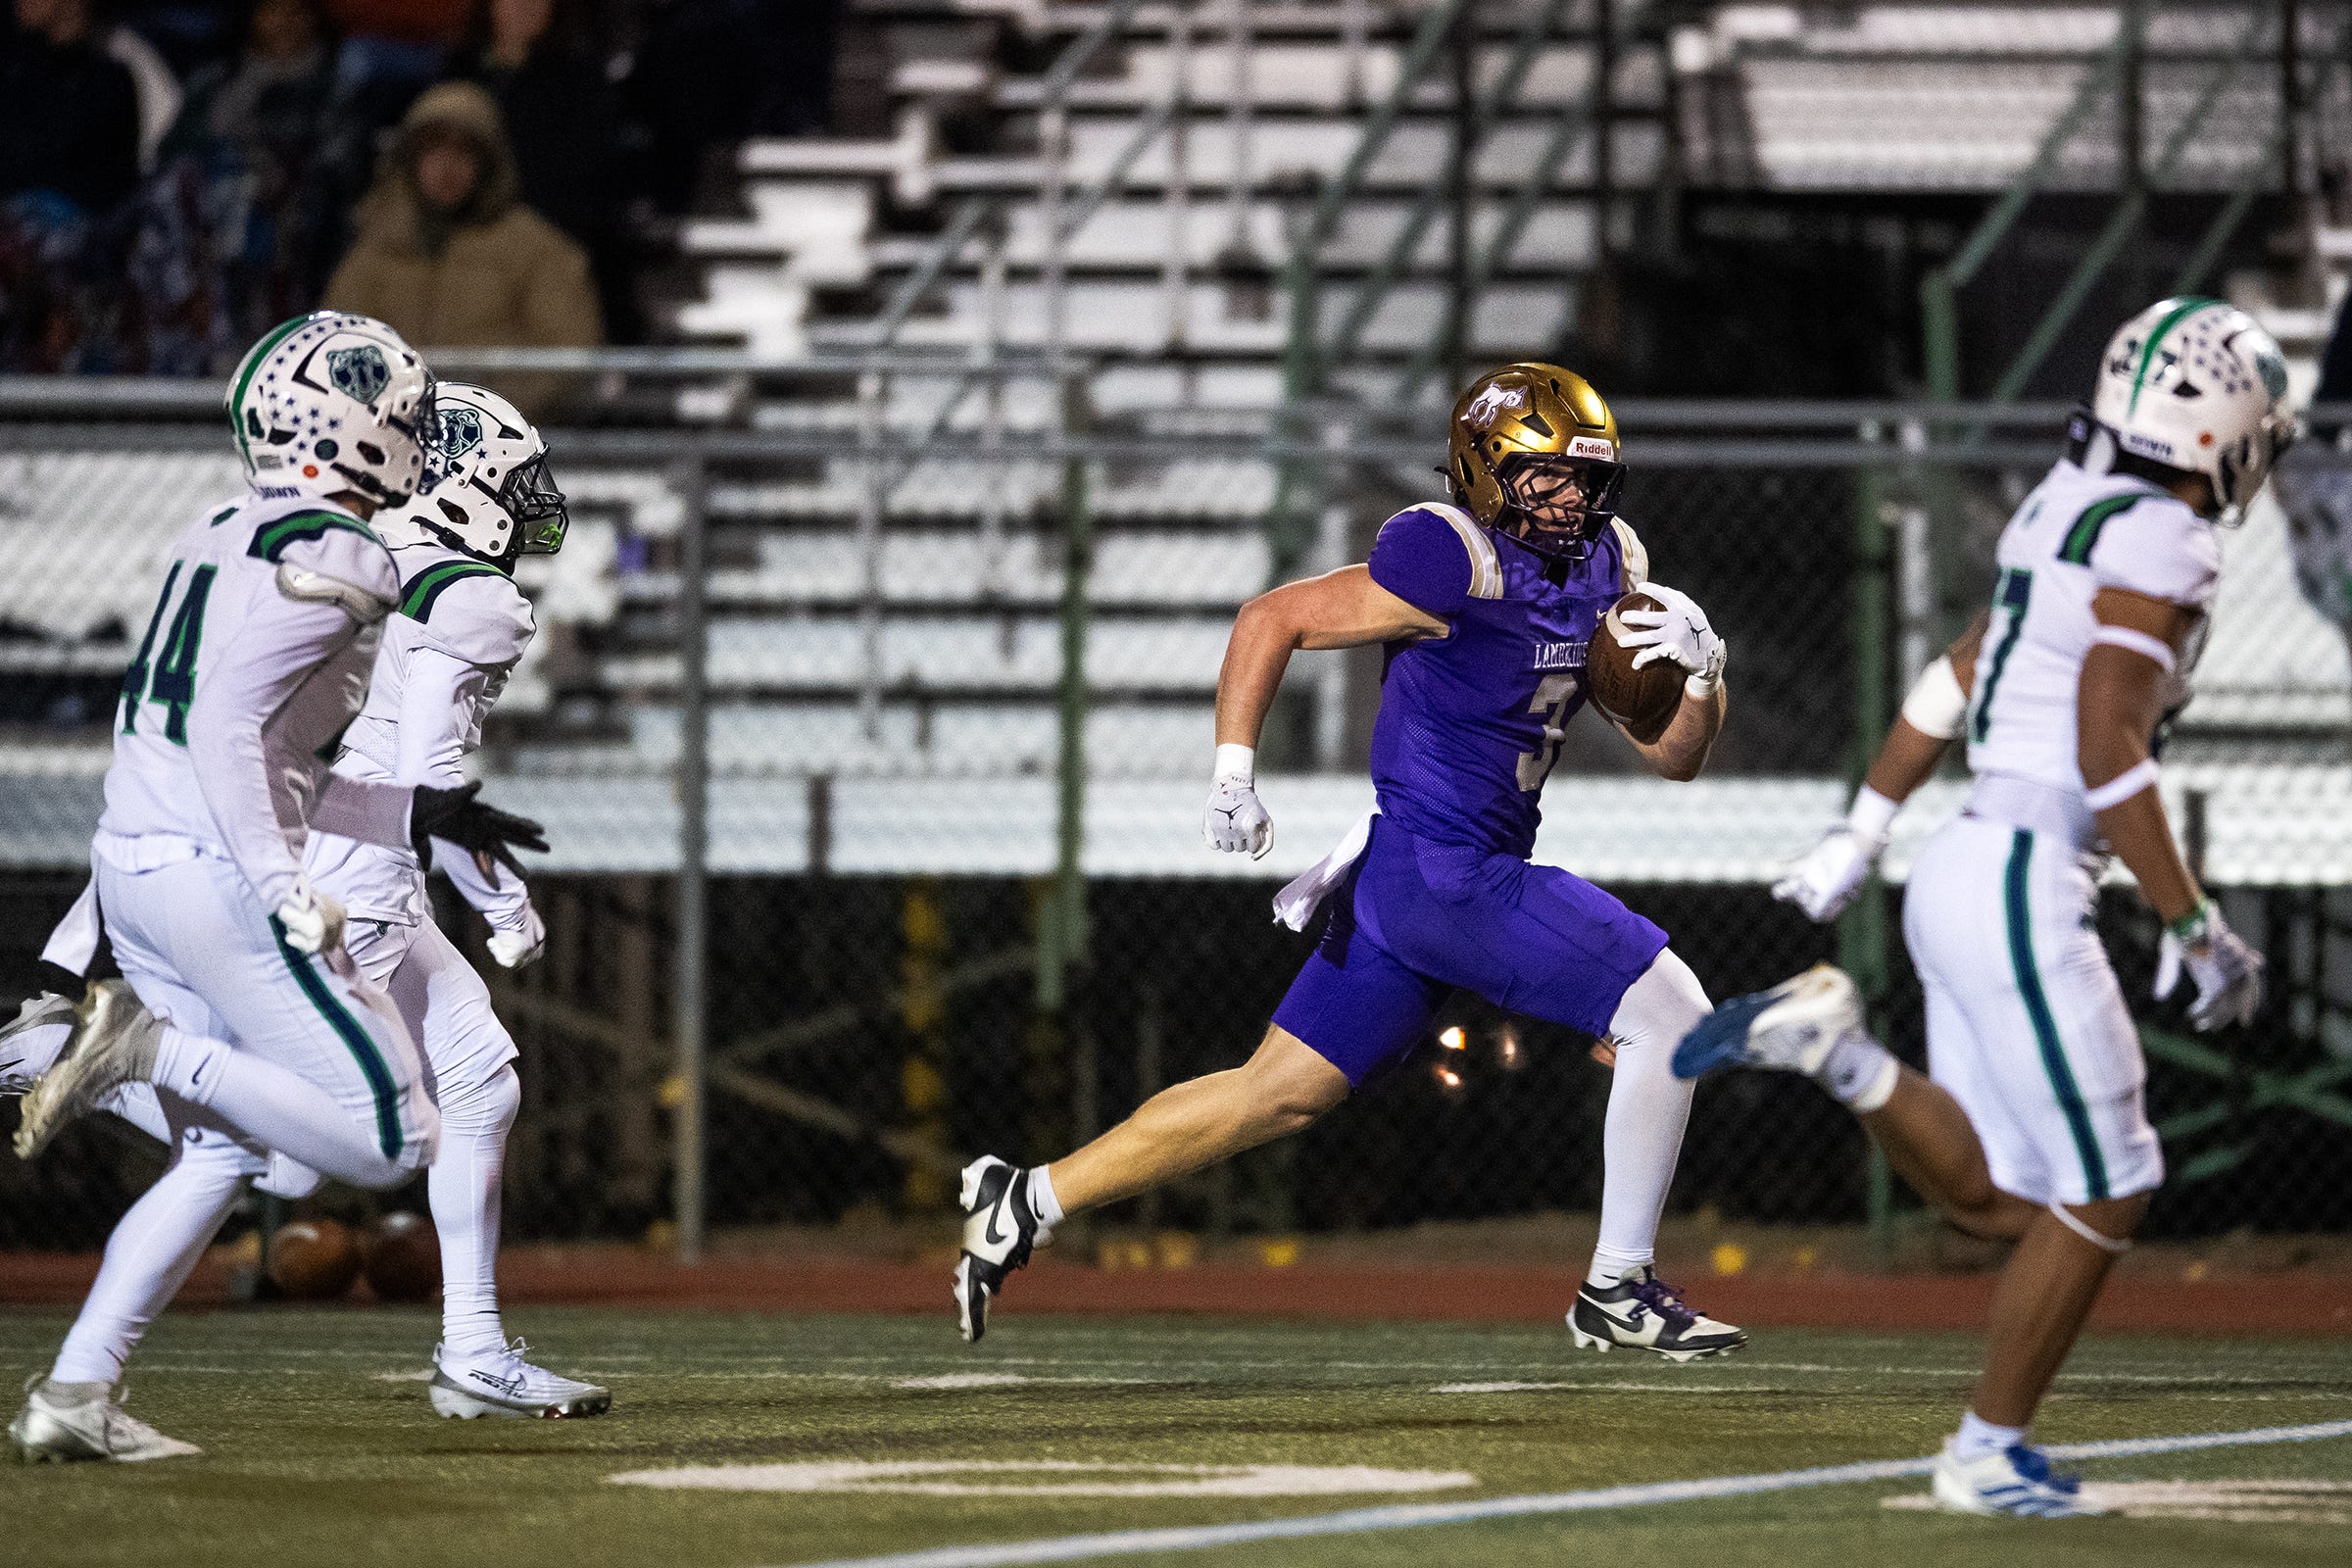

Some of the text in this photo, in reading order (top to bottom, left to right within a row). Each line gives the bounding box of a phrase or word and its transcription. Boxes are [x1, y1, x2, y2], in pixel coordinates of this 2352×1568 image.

[1576, 442, 1612, 457] Riddell
[121, 559, 219, 748] 44
[1515, 673, 1579, 793] 3
